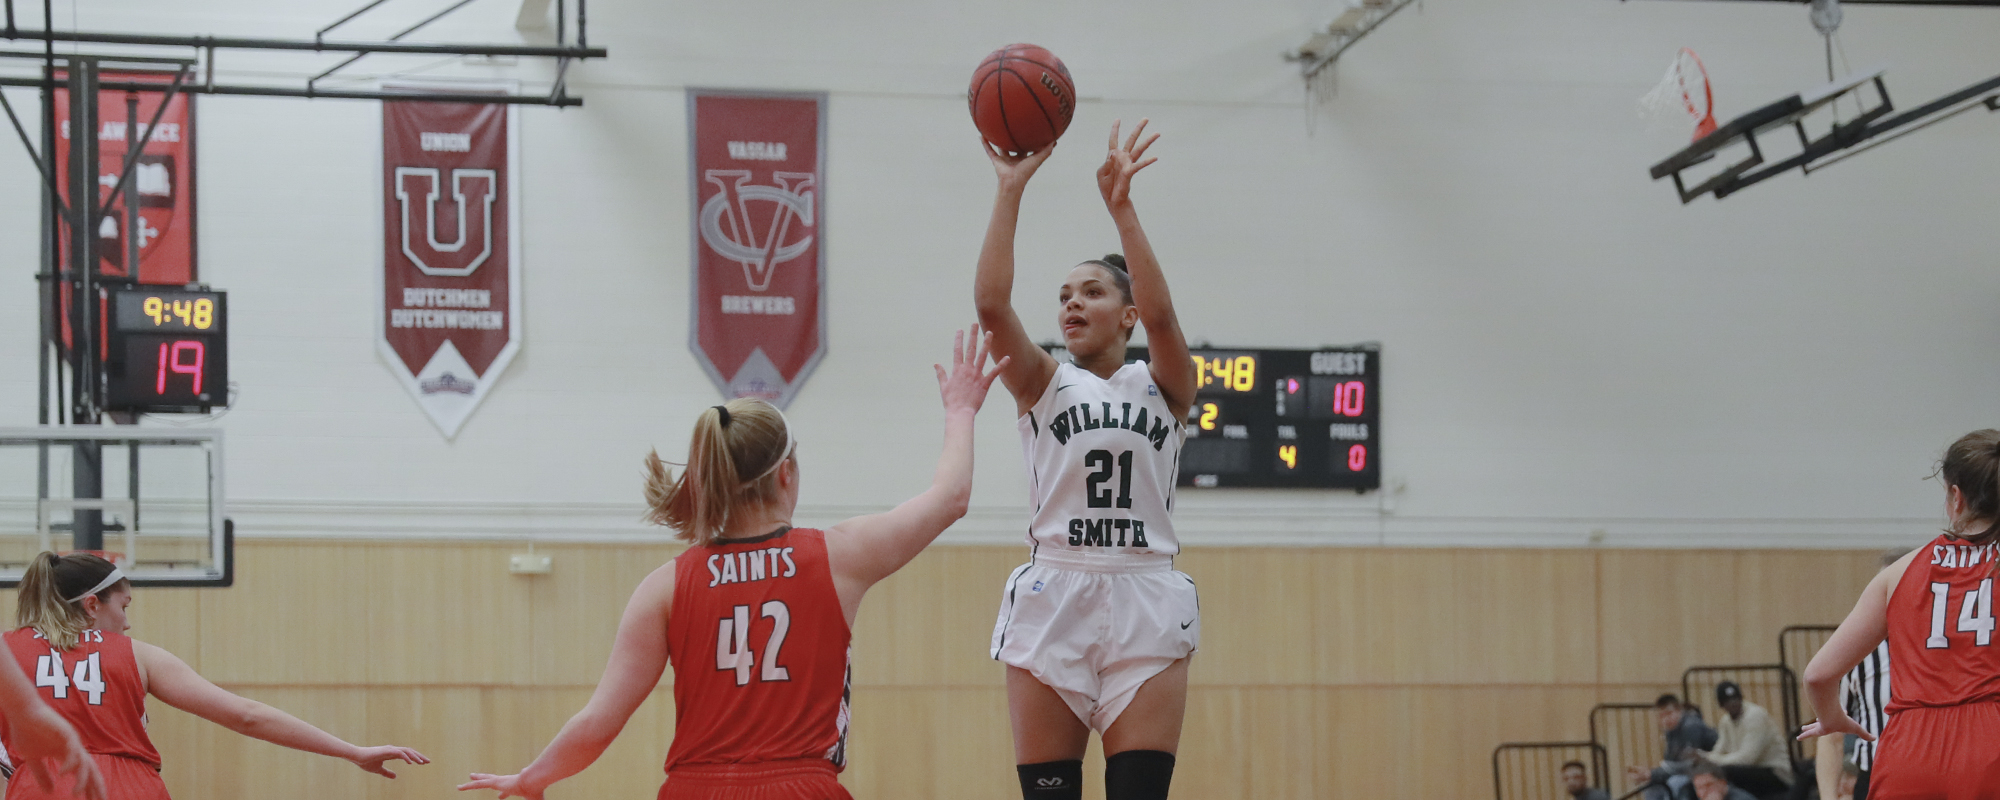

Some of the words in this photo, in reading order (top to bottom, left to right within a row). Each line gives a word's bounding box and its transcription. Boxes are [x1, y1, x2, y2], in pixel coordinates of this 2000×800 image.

[420, 131, 471, 152] UNION
[727, 140, 788, 161] VASSAR
[395, 166, 496, 276] U
[403, 287, 491, 308] DUTCHMEN
[721, 295, 795, 315] BREWERS
[143, 296, 214, 329] 9:48
[391, 309, 503, 330] DUTCHWOMEN
[156, 340, 205, 395] 19
[1310, 352, 1367, 375] GUEST
[1332, 380, 1366, 417] 10
[1049, 402, 1170, 452] WILLIAM
[1200, 402, 1219, 431] 2
[1329, 423, 1369, 441] FOULS
[1278, 445, 1297, 469] 4
[1348, 444, 1367, 471] 0
[1085, 449, 1133, 509] 21
[1068, 519, 1148, 547] SMITH
[707, 547, 797, 588] SAINTS
[1926, 577, 1996, 649] 14
[716, 599, 791, 687] 42
[35, 647, 106, 706] 44
